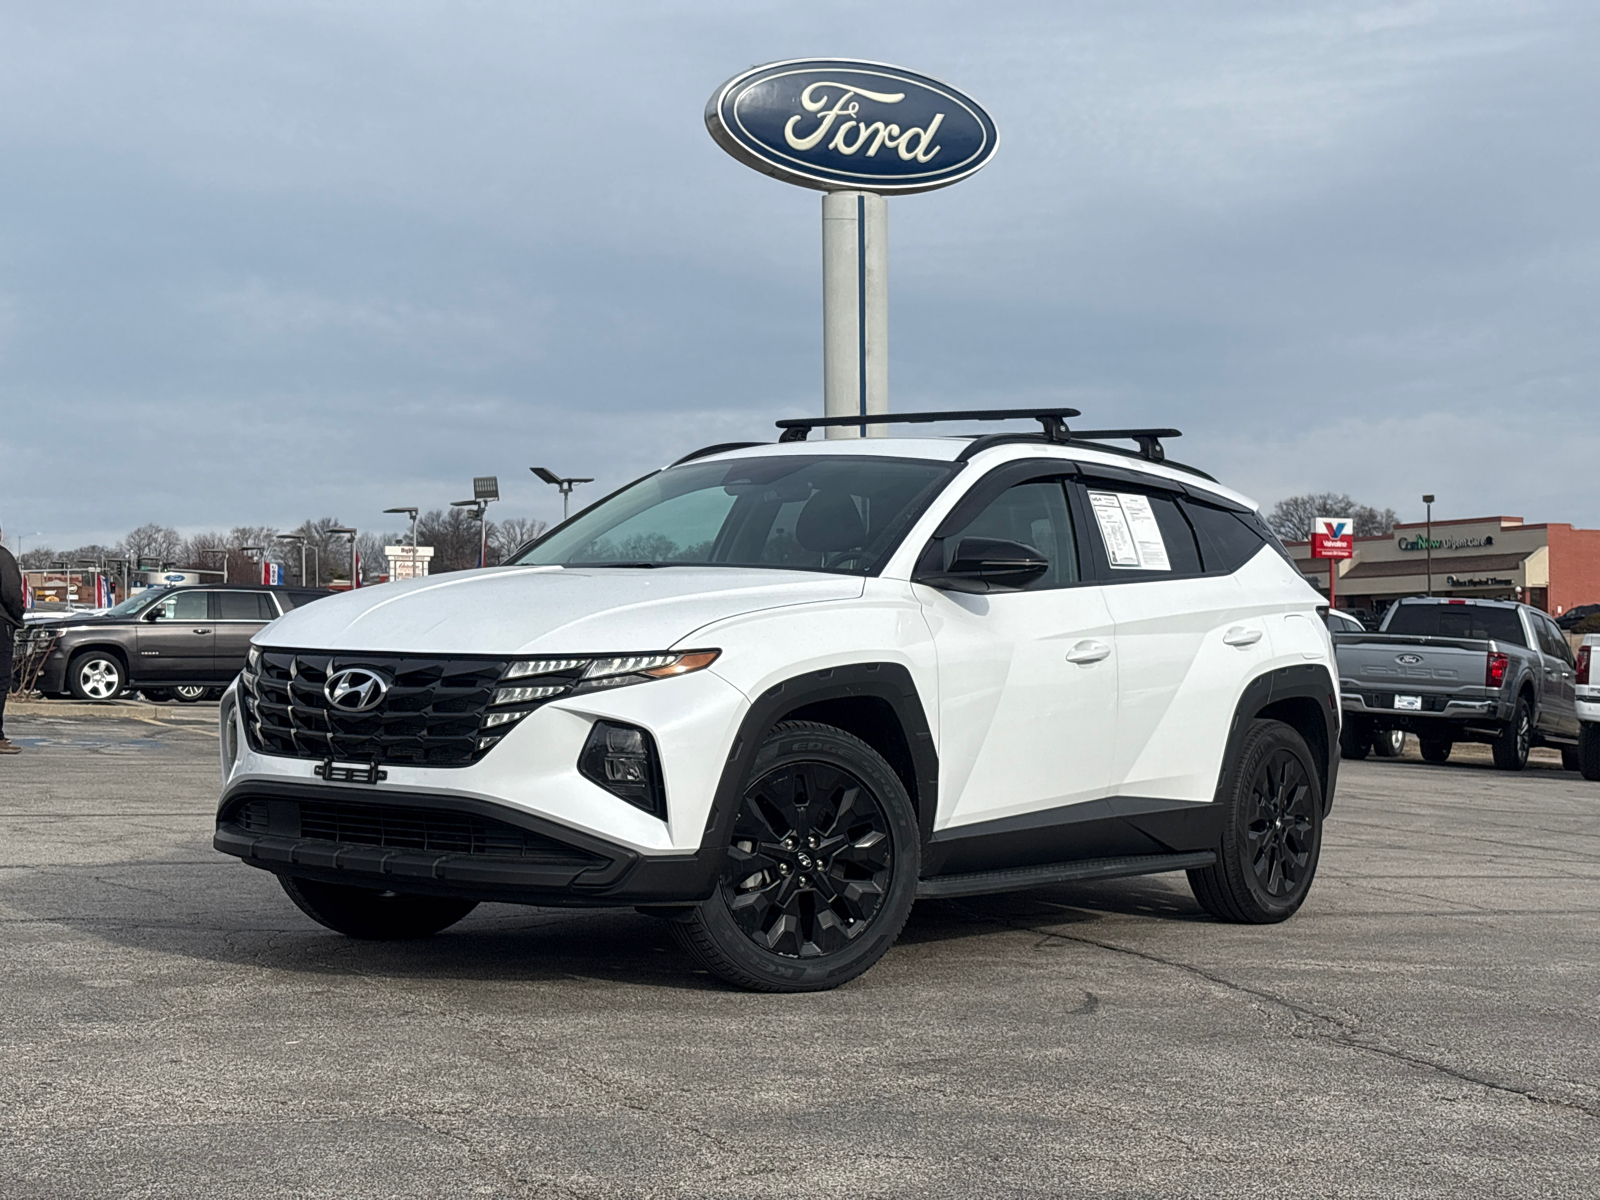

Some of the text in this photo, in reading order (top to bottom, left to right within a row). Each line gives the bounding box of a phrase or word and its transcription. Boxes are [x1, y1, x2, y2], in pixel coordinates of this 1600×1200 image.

[784, 81, 945, 164] Ford
[1361, 665, 1458, 679] F-150
[792, 742, 853, 758] EDGE
[861, 761, 905, 827] SPORT
